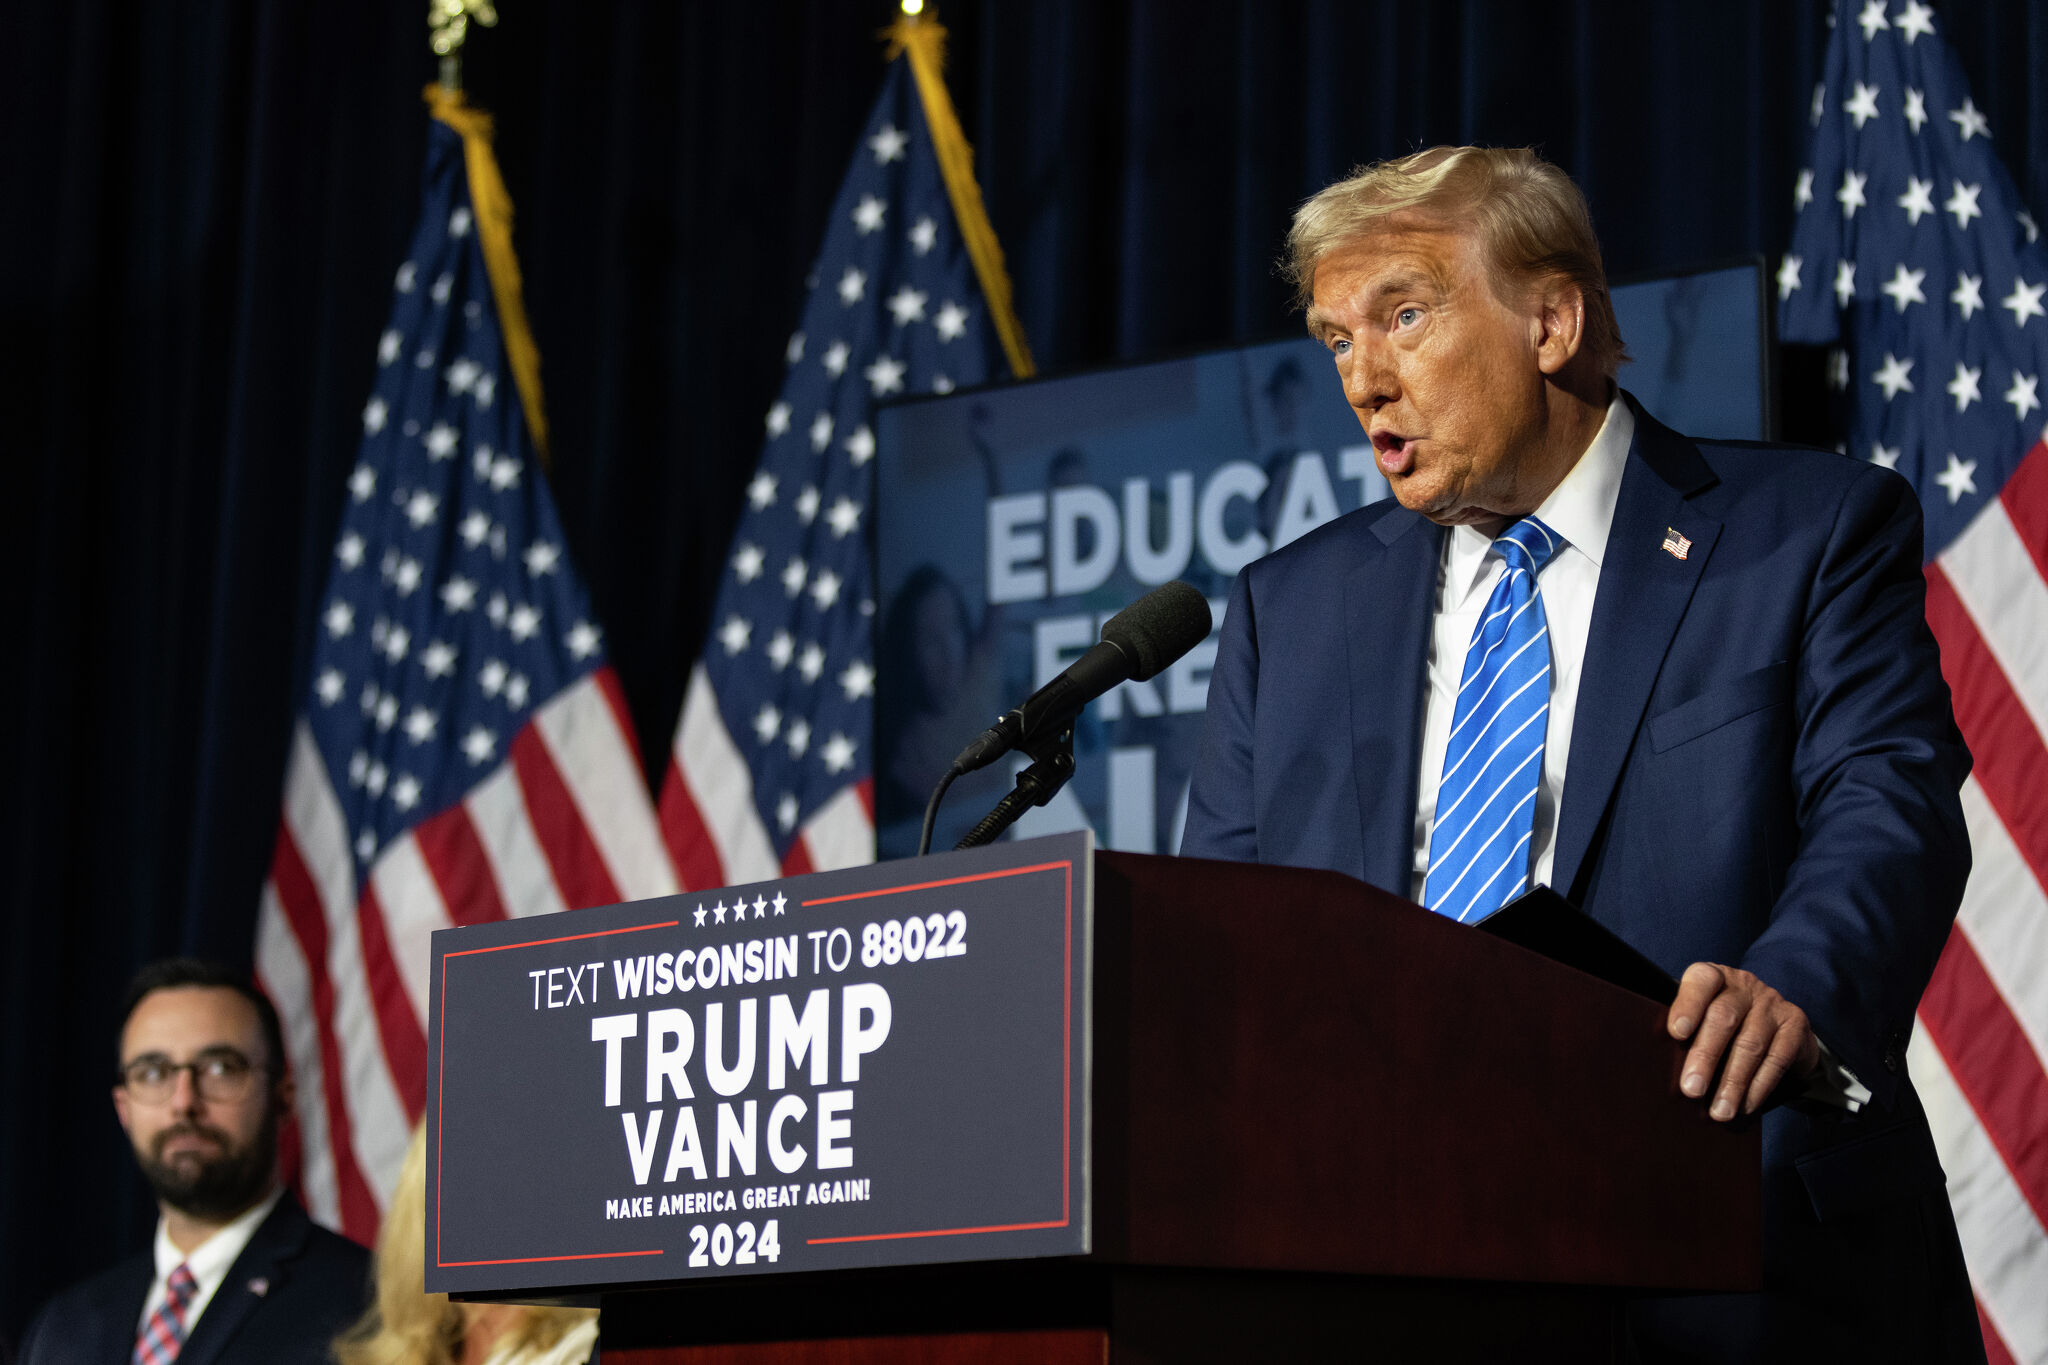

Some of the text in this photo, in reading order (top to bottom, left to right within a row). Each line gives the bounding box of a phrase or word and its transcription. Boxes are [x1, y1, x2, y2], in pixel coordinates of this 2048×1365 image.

[528, 909, 967, 1011] TEXT WISCONSIN TO 88022
[591, 982, 892, 1108] TRUMP
[621, 1089, 854, 1186] VANCE
[606, 1178, 871, 1220] MAKE AMERICA GREAT AGAIN!
[688, 1219, 781, 1268] 2024
